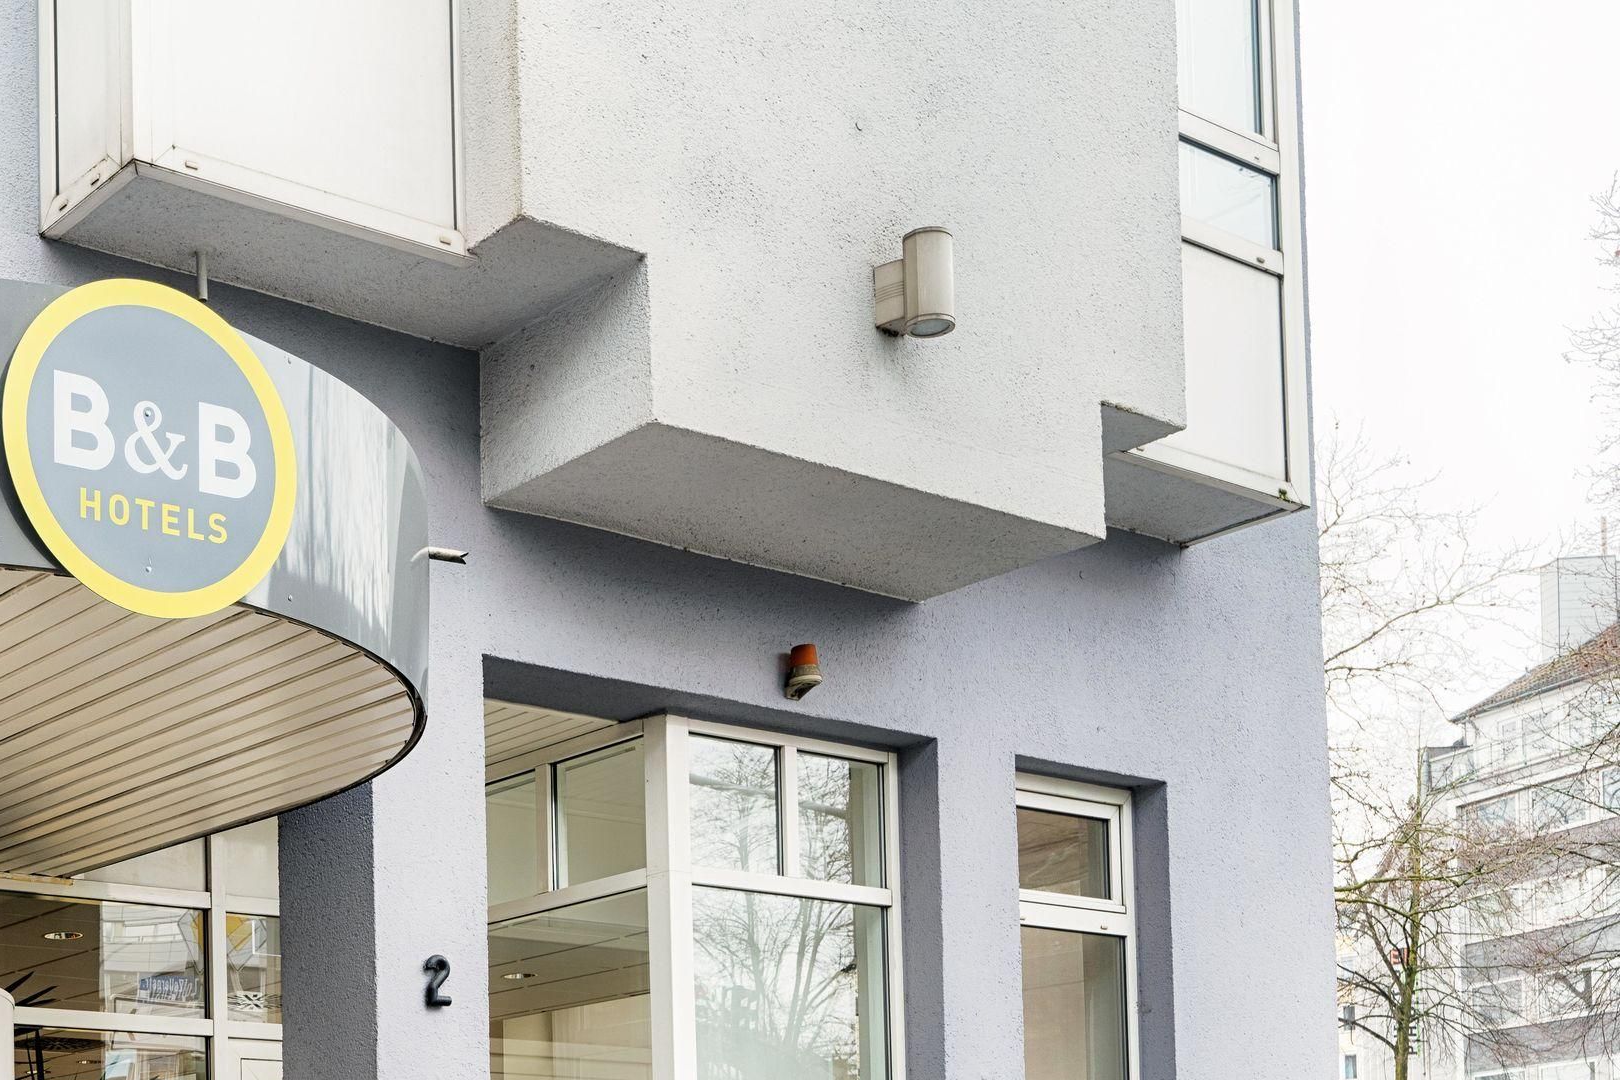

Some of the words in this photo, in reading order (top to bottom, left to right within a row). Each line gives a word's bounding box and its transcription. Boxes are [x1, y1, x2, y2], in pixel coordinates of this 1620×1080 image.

[53, 369, 257, 499] B&B
[79, 487, 229, 544] HOTELS
[424, 954, 452, 1007] 2
